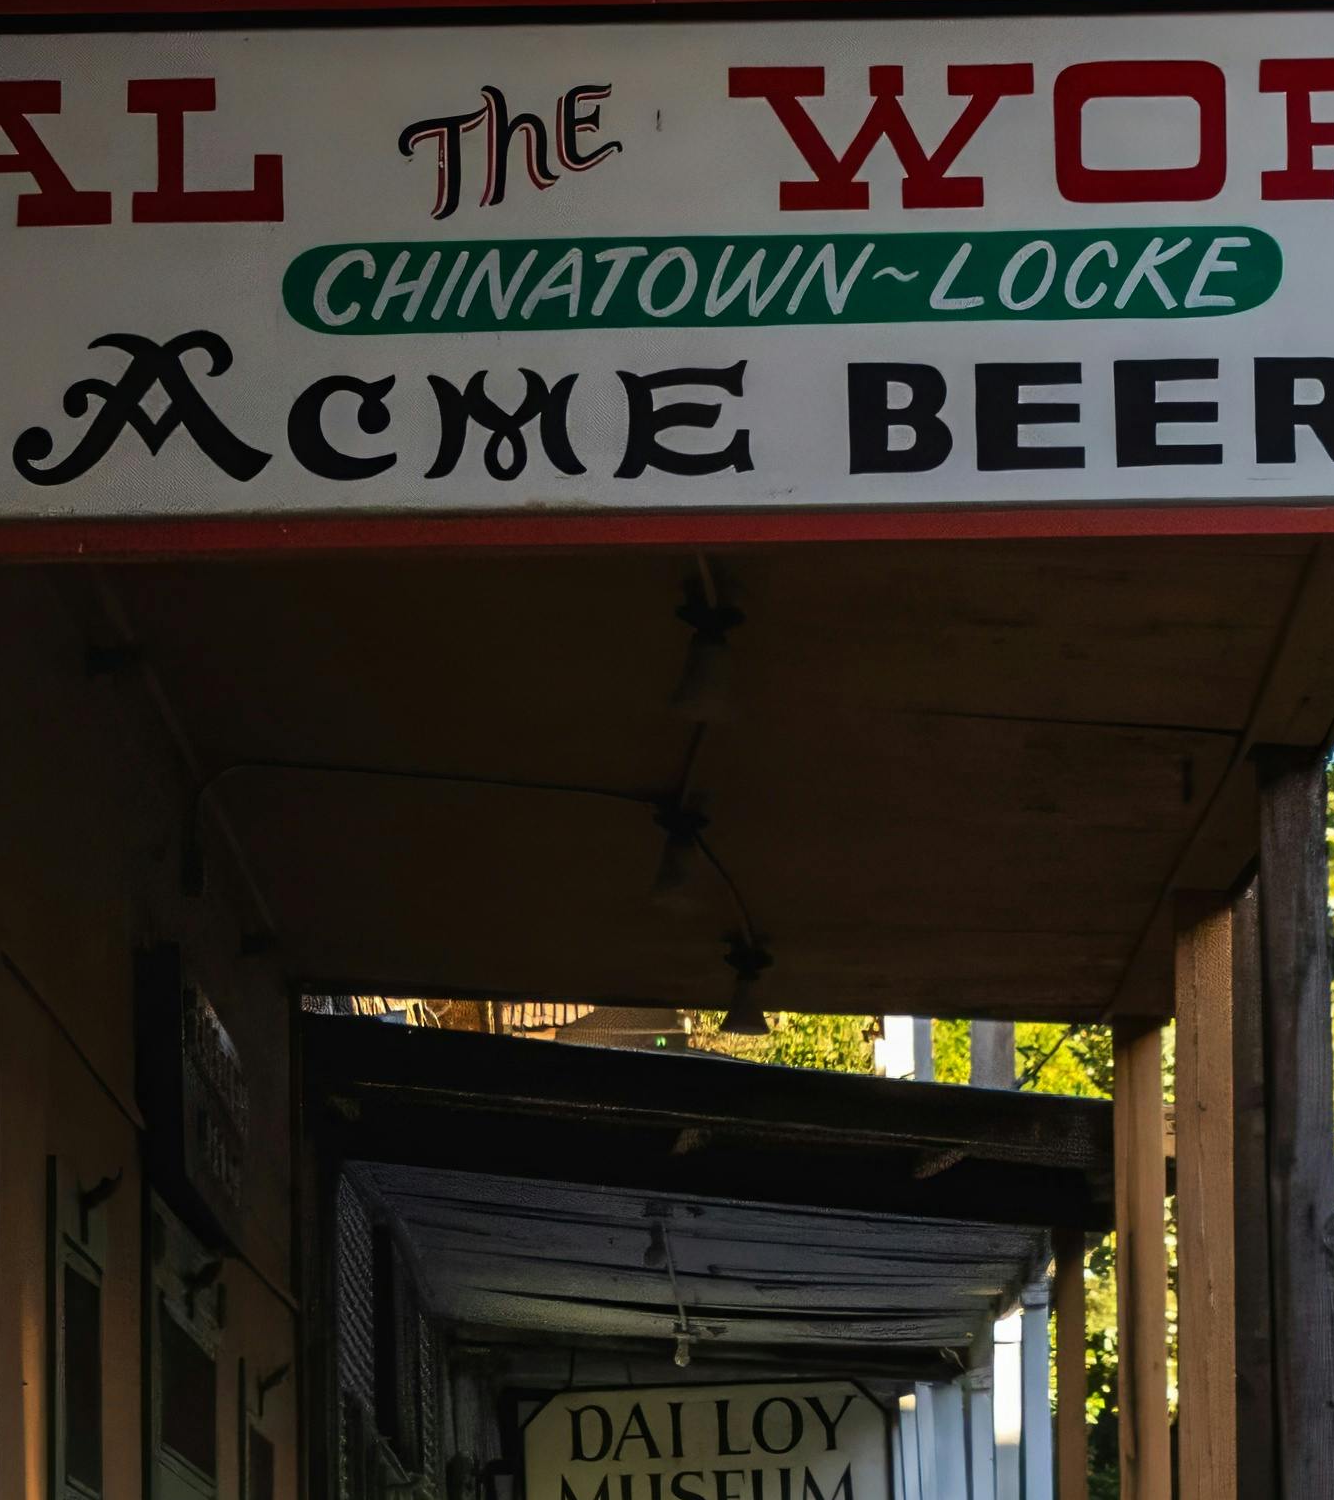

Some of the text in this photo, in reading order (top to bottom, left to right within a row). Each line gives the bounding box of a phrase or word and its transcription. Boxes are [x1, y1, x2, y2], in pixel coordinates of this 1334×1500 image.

[13, 330, 754, 486] ACME
[570, 1394, 857, 1462] DAI LOY
